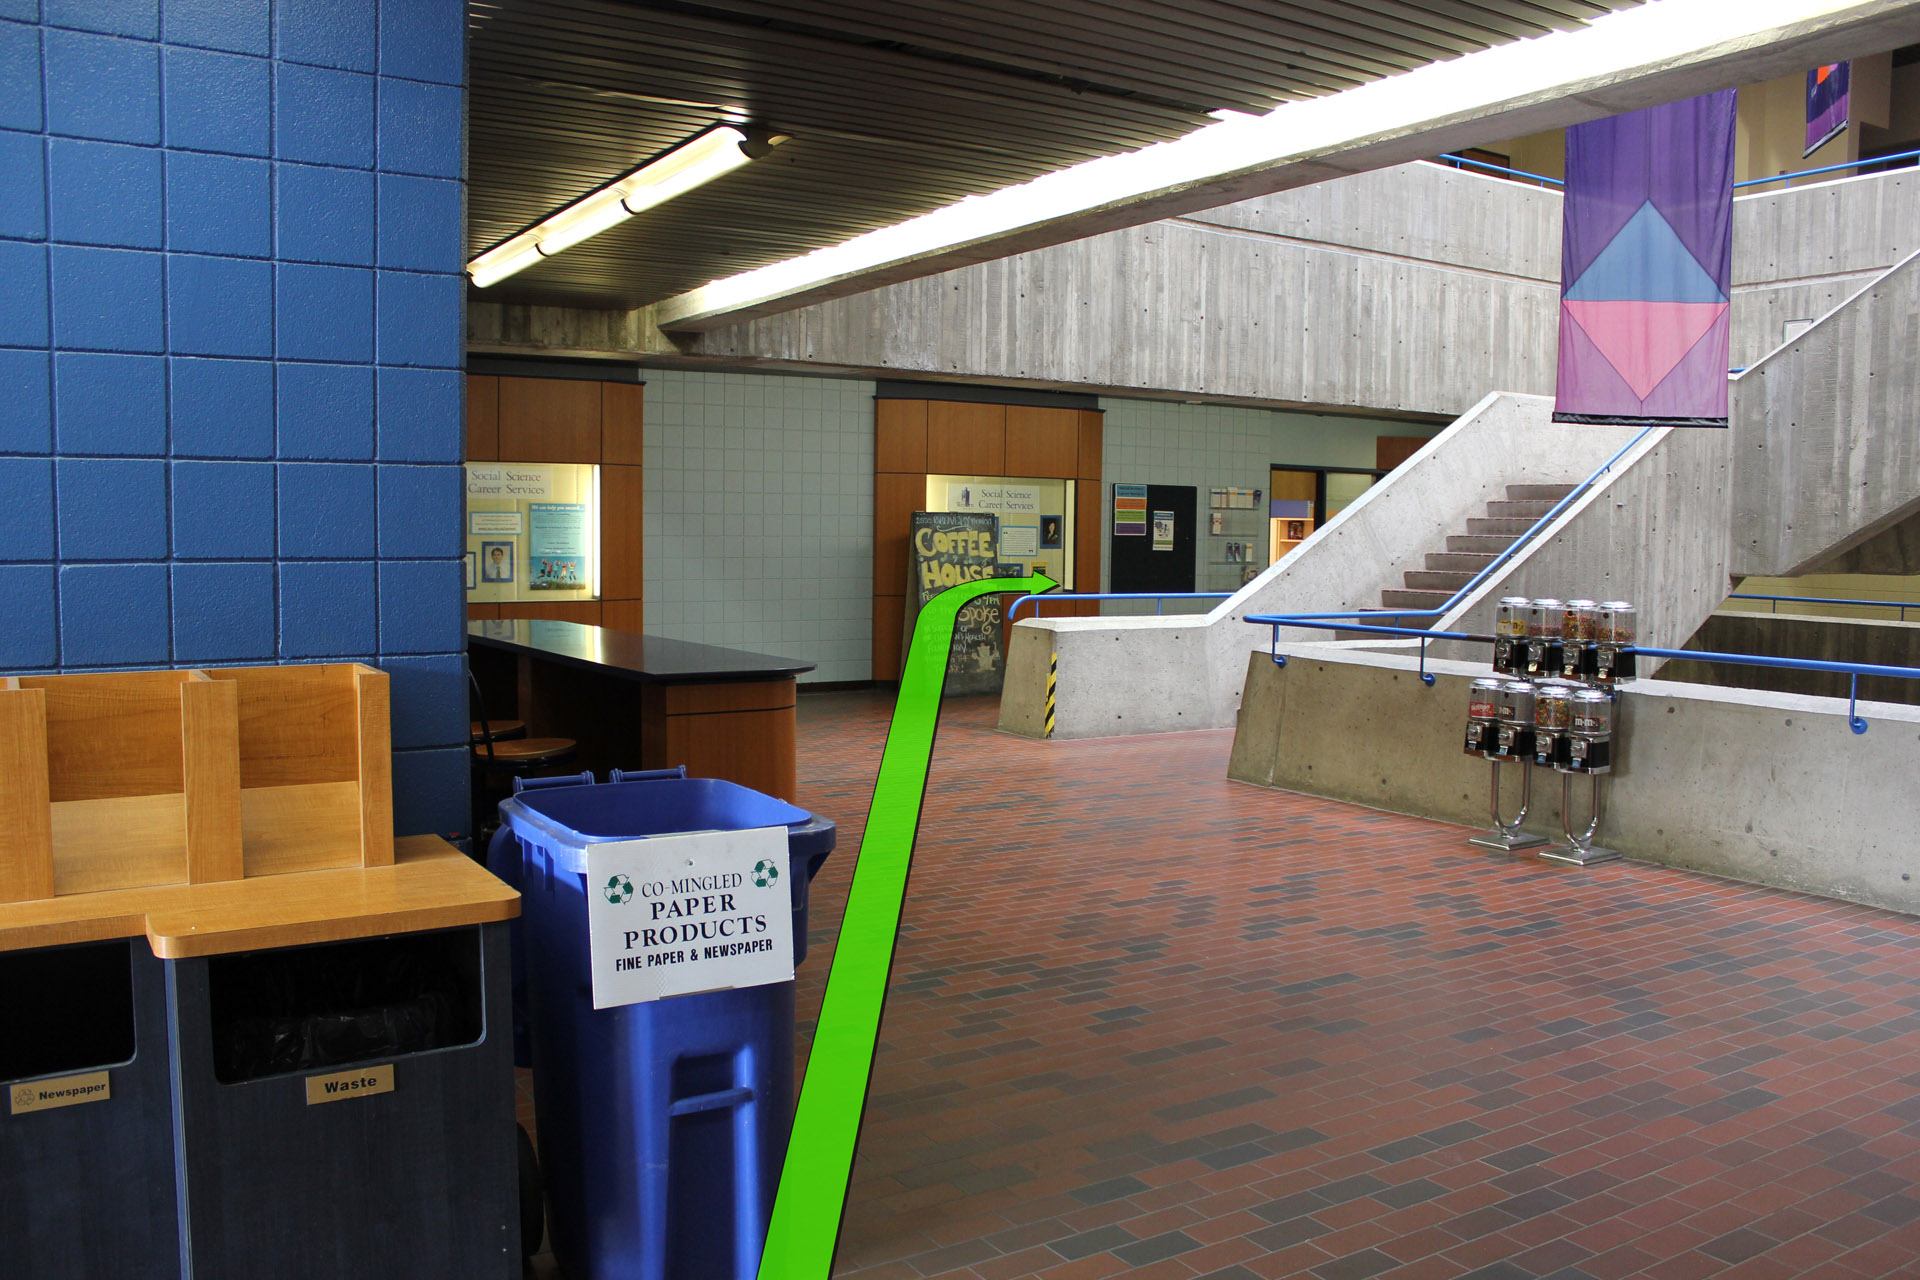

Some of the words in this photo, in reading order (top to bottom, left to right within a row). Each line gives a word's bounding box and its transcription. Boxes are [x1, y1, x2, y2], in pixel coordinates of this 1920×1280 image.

[471, 470, 501, 481] Social
[505, 471, 542, 482] Science
[467, 483, 501, 494] Career
[505, 484, 545, 495] Services
[981, 488, 1003, 498] Social
[1006, 490, 1032, 499] Science
[978, 500, 1003, 509] Career
[1005, 501, 1034, 510] Services
[915, 527, 995, 558] COFFEE
[921, 560, 995, 589] HOUSE
[641, 872, 743, 898] CO-MINGLED
[650, 893, 737, 921] PAPER
[623, 914, 768, 950] PRODUCTS
[615, 956, 642, 972] FINE
[647, 950, 685, 967] PAPER
[690, 949, 699, 962] &
[704, 938, 774, 960] NEWSPAPER
[38, 1082, 107, 1101] Newspaper
[324, 1075, 378, 1094] Waste
